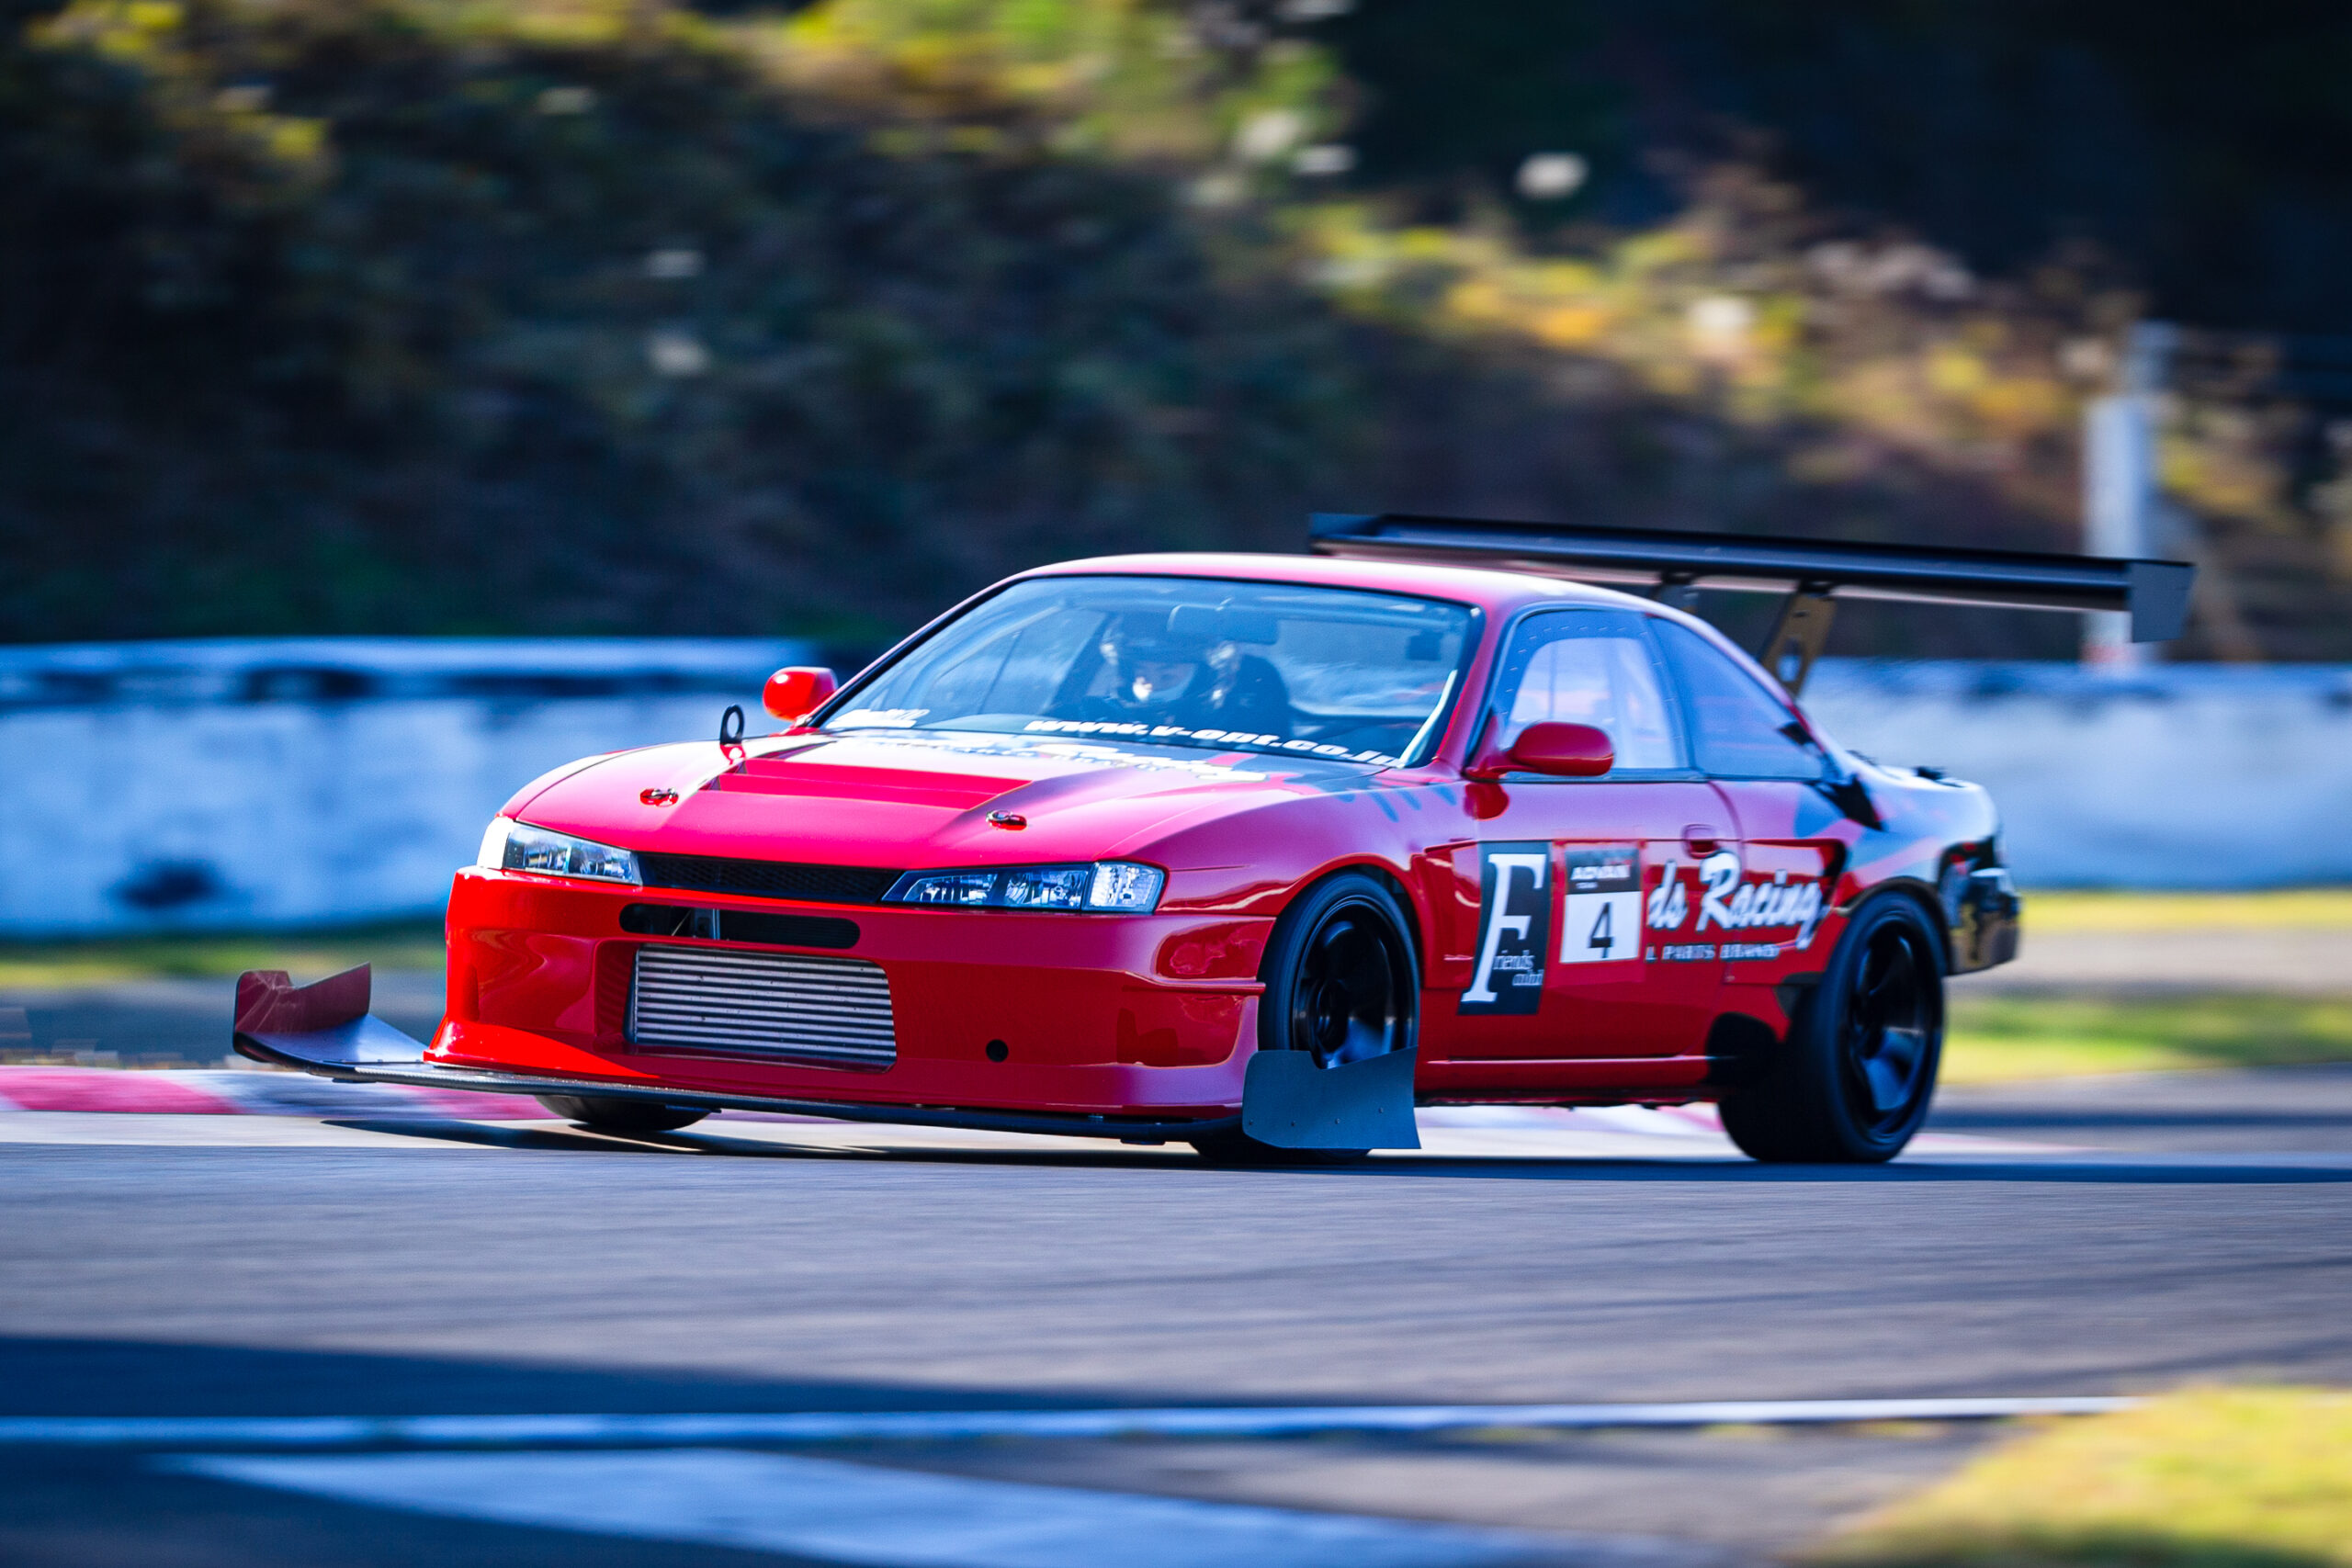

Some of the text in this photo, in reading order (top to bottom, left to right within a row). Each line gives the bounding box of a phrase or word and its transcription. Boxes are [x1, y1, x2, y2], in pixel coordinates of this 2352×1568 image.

[1696, 852, 1831, 950] Racing
[1588, 902, 1615, 959] 4
[1662, 945, 1715, 961] PARTS
